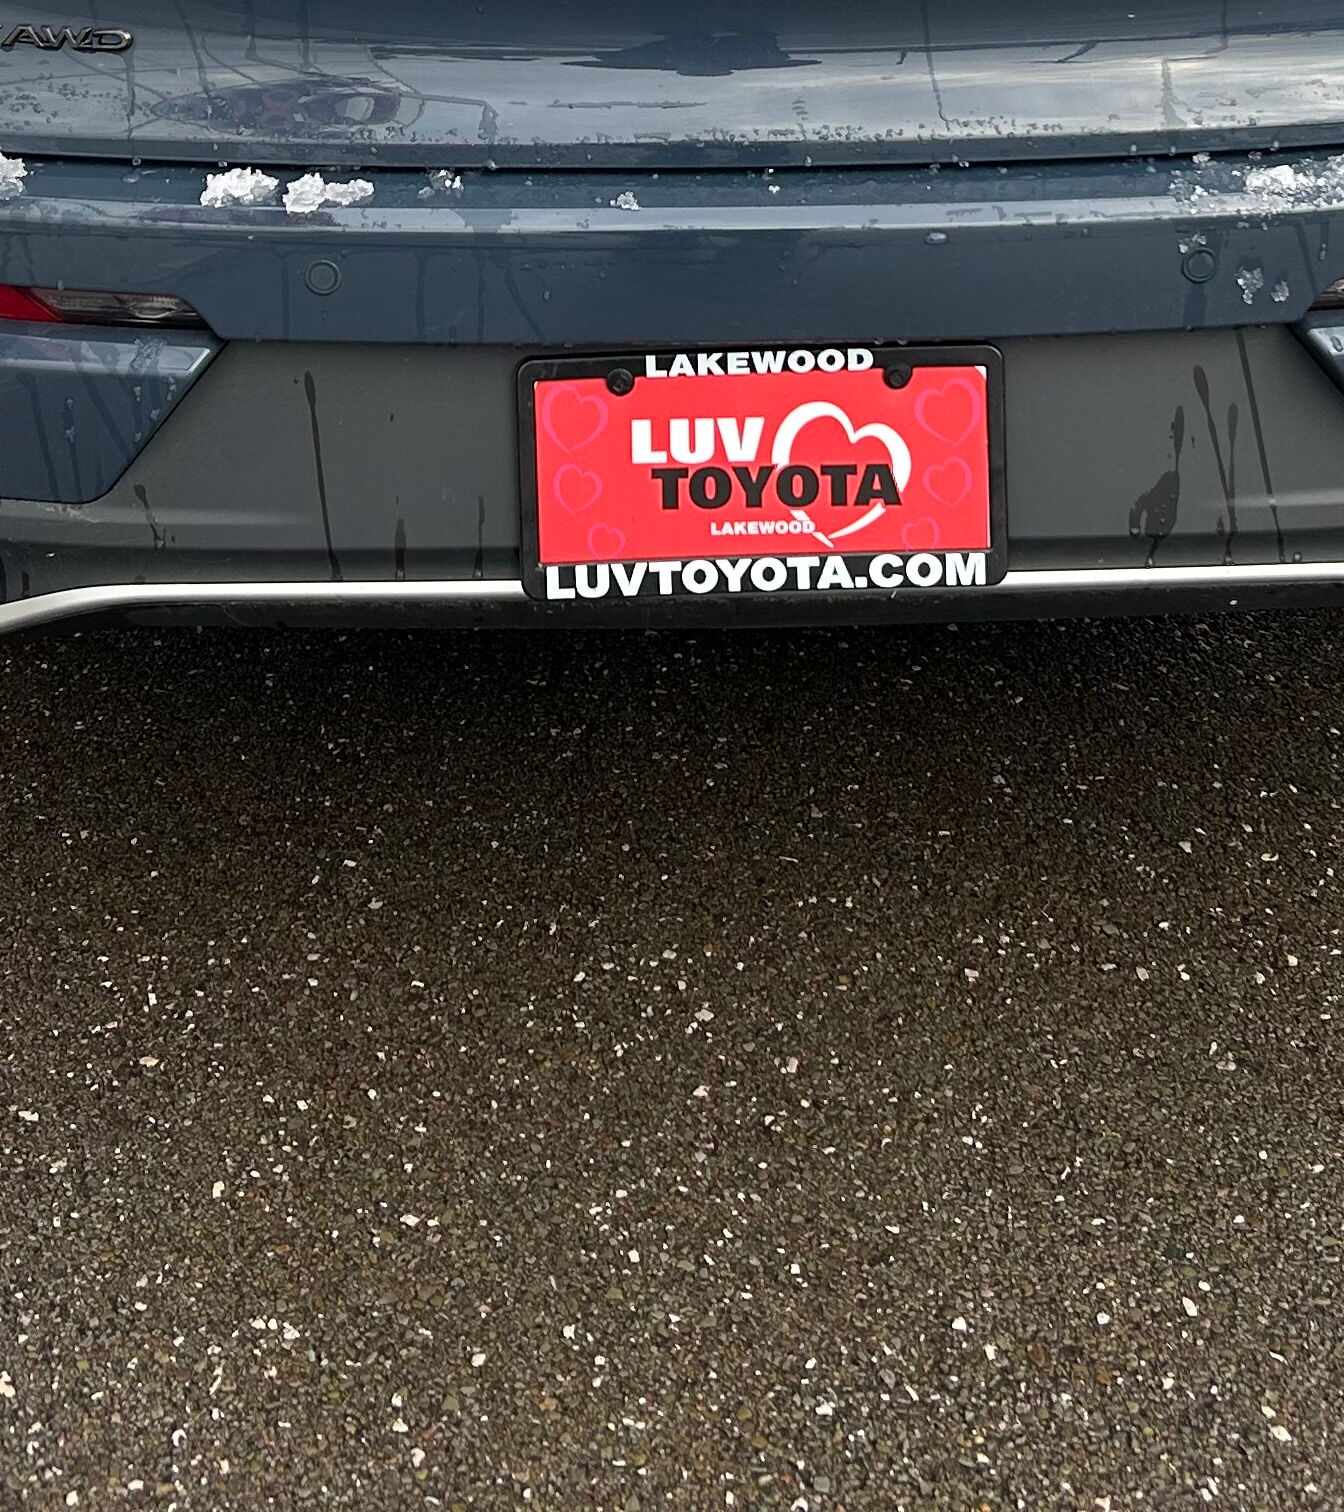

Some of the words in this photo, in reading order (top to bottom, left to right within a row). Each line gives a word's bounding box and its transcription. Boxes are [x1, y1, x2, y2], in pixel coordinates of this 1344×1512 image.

[646, 348, 874, 378] LAKEWOOD
[631, 417, 766, 464] LUV
[651, 464, 902, 511] TOYOTA
[710, 519, 816, 537] LAKEWOOD
[545, 552, 987, 600] LUVTOYOTA.COM
